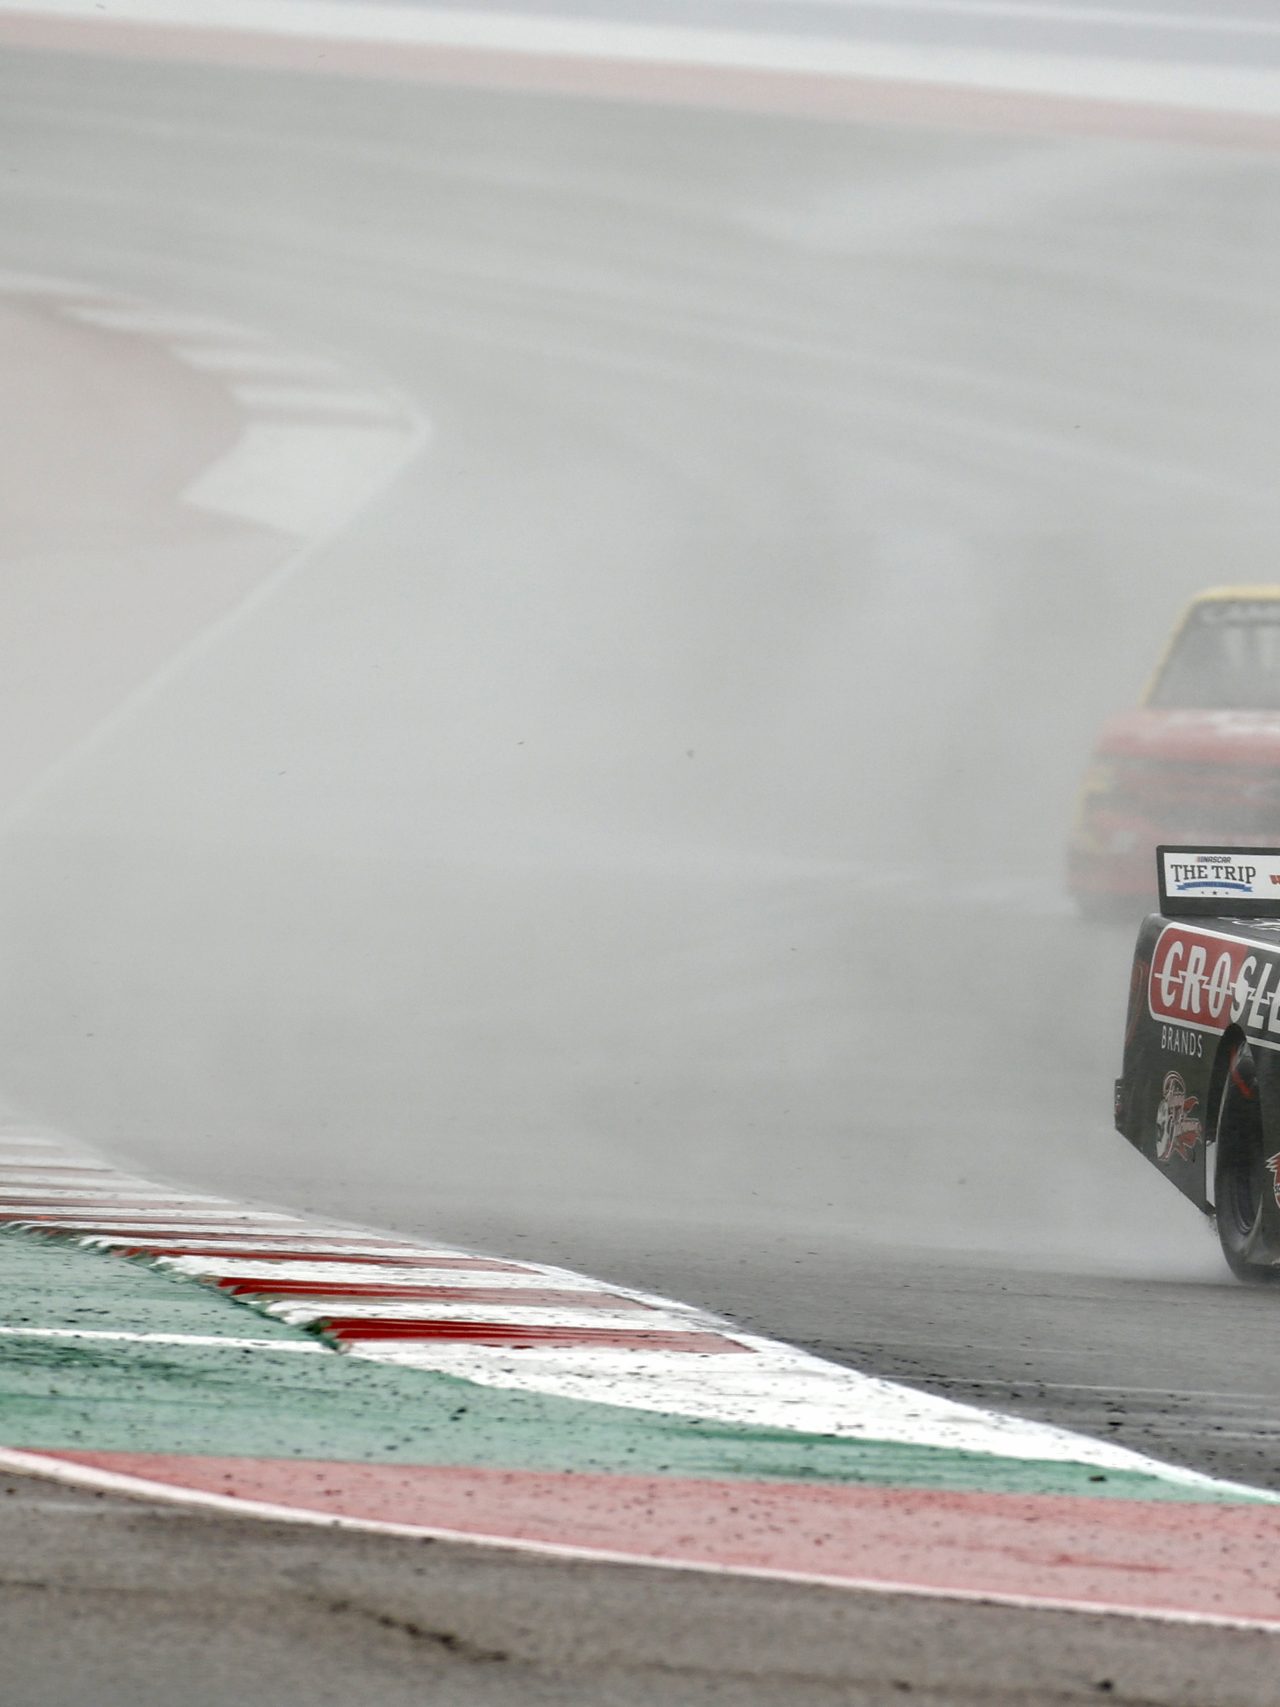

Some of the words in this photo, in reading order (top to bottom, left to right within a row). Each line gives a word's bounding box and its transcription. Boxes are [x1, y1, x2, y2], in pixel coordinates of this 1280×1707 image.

[1171, 864, 1208, 882] THE
[1211, 865, 1256, 884] TRIP
[1161, 1025, 1203, 1058] BRANDS
